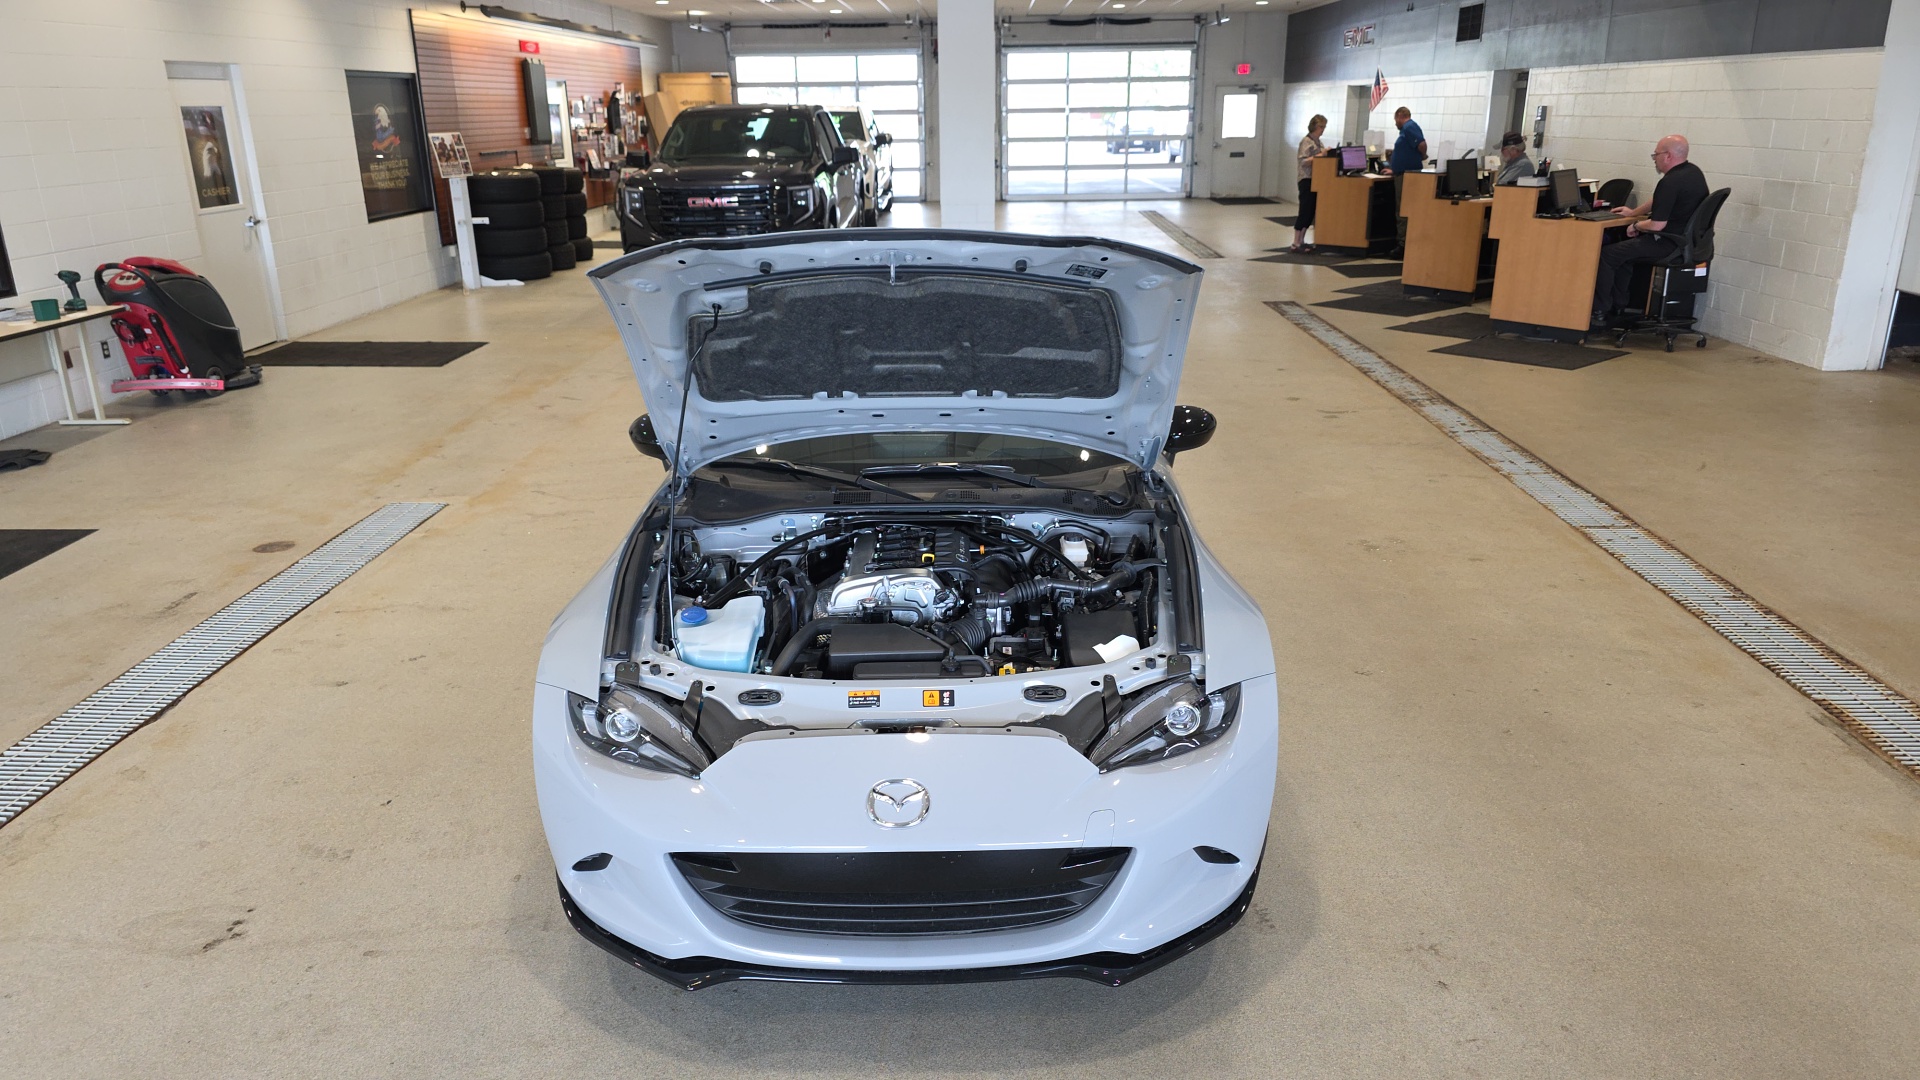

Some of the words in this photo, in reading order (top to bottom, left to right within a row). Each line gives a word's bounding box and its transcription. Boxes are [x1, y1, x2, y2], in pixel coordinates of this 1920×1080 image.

[1343, 23, 1376, 49] GMC
[202, 186, 231, 197] CASHIER
[687, 196, 739, 207] GMC
